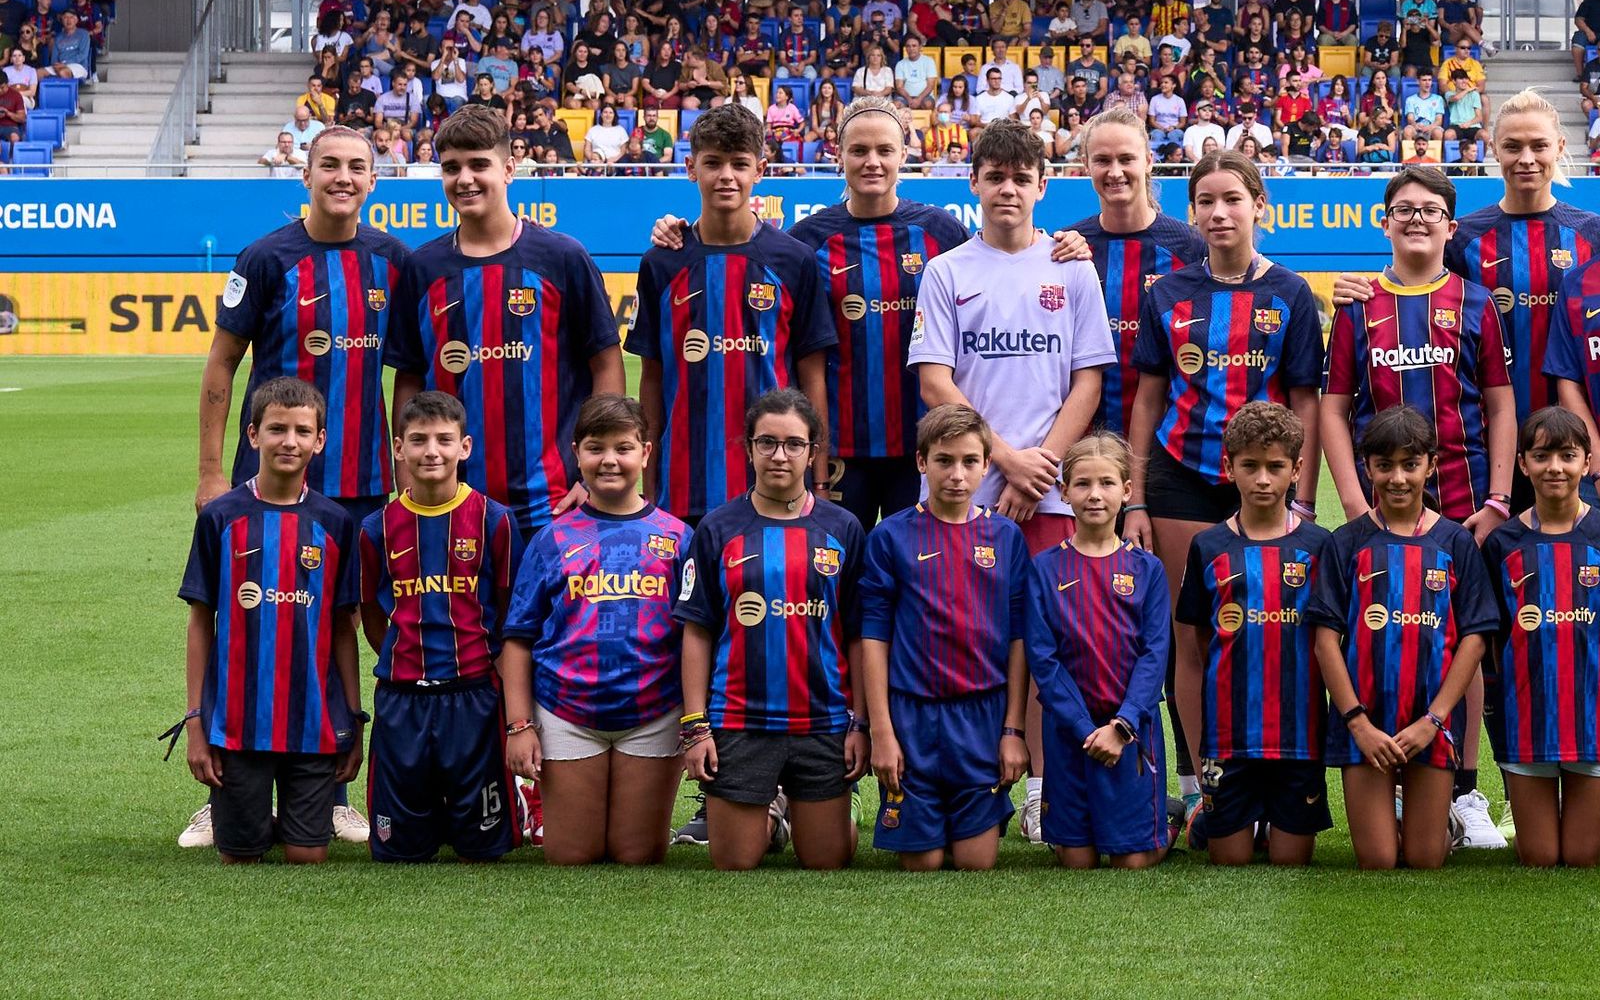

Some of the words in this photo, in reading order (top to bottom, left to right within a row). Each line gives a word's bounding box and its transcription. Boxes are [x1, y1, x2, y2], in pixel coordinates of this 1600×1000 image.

[0, 202, 117, 229] CELONA
[368, 202, 428, 233] QUE
[1259, 202, 1314, 233] QUE
[1322, 203, 1362, 229] UN
[334, 332, 383, 351] Spotify
[470, 342, 533, 363] Spotify
[713, 335, 770, 355] Spotify
[963, 327, 1062, 354] Rakuten
[1207, 349, 1271, 372] Spotify
[1371, 342, 1455, 368] Rakuten
[264, 587, 315, 609] Spotify
[393, 574, 479, 598] STANLEY
[770, 597, 830, 621] Spotify
[1391, 610, 1442, 630] Spotify
[1545, 606, 1597, 625] Spotify
[481, 780, 502, 817] 15
